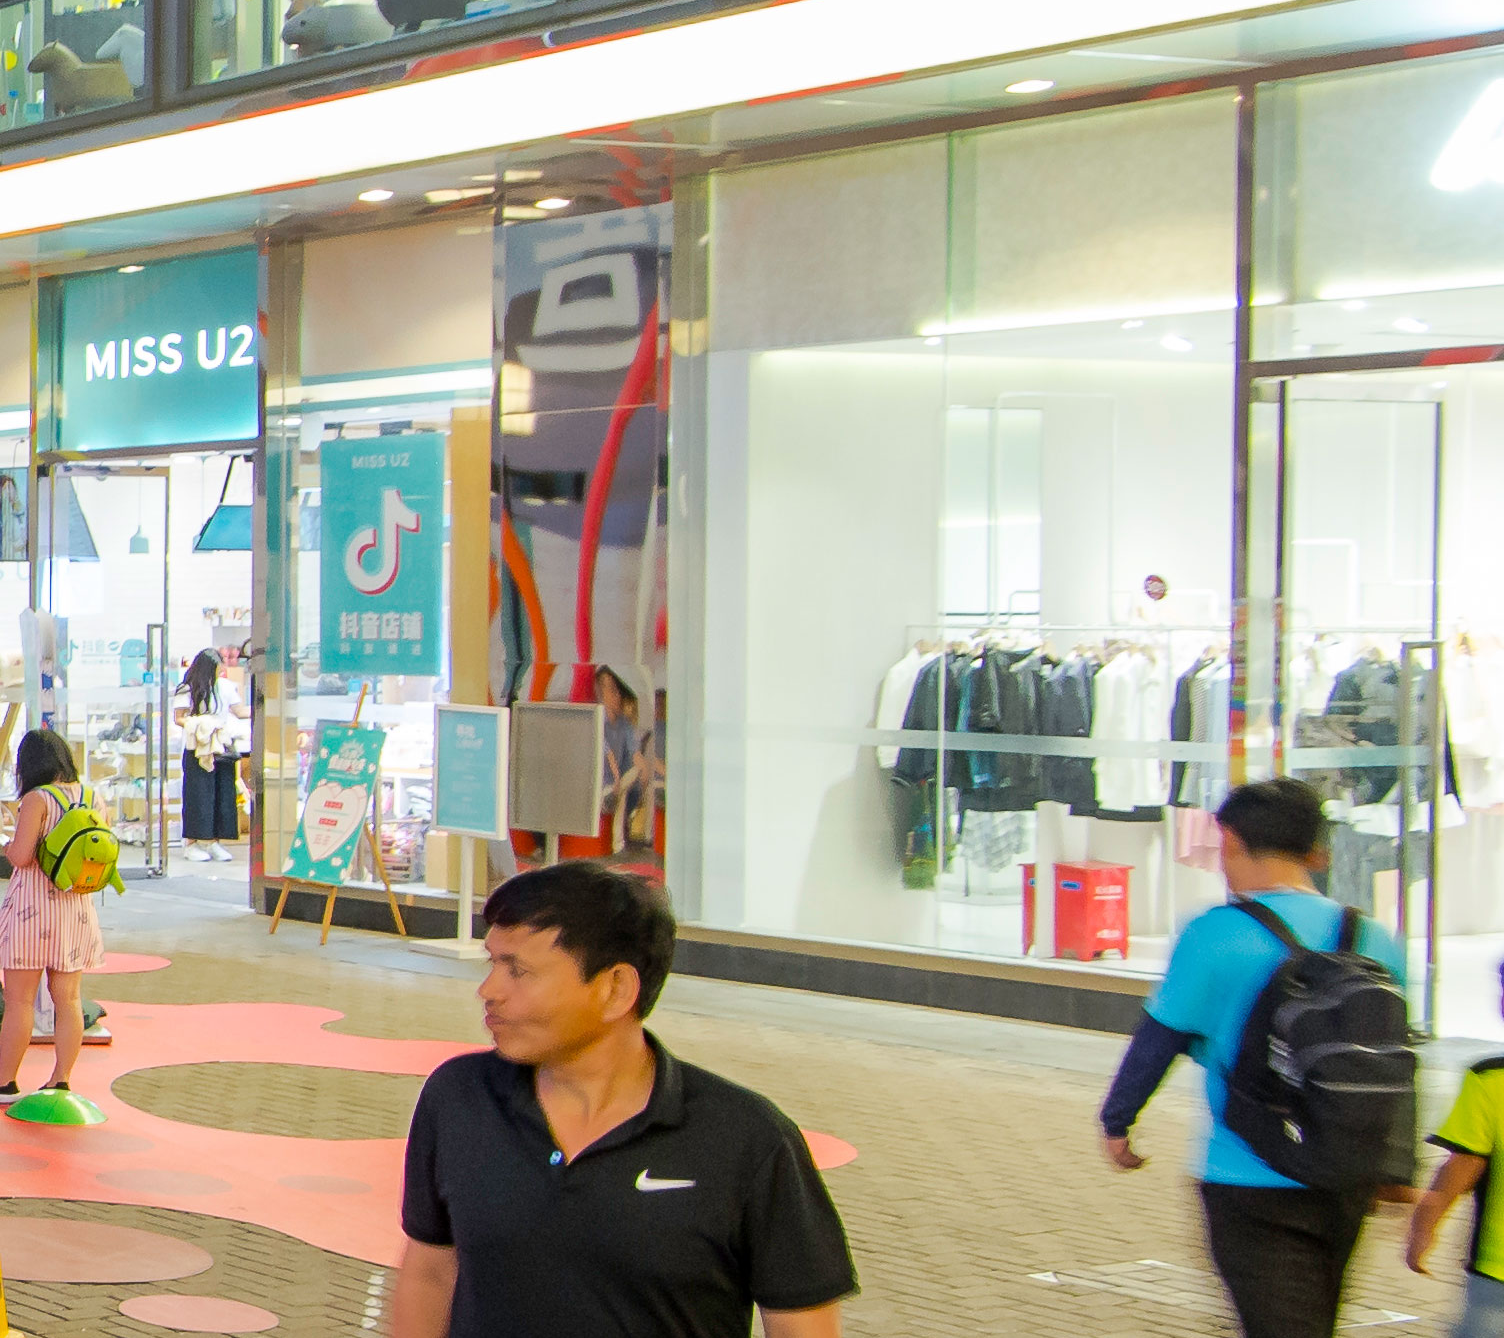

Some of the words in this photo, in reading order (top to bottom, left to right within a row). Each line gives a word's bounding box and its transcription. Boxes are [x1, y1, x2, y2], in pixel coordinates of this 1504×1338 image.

[84, 332, 184, 383] MISS
[196, 323, 256, 371] U2
[351, 454, 386, 470] MISS
[389, 452, 411, 468] U2
